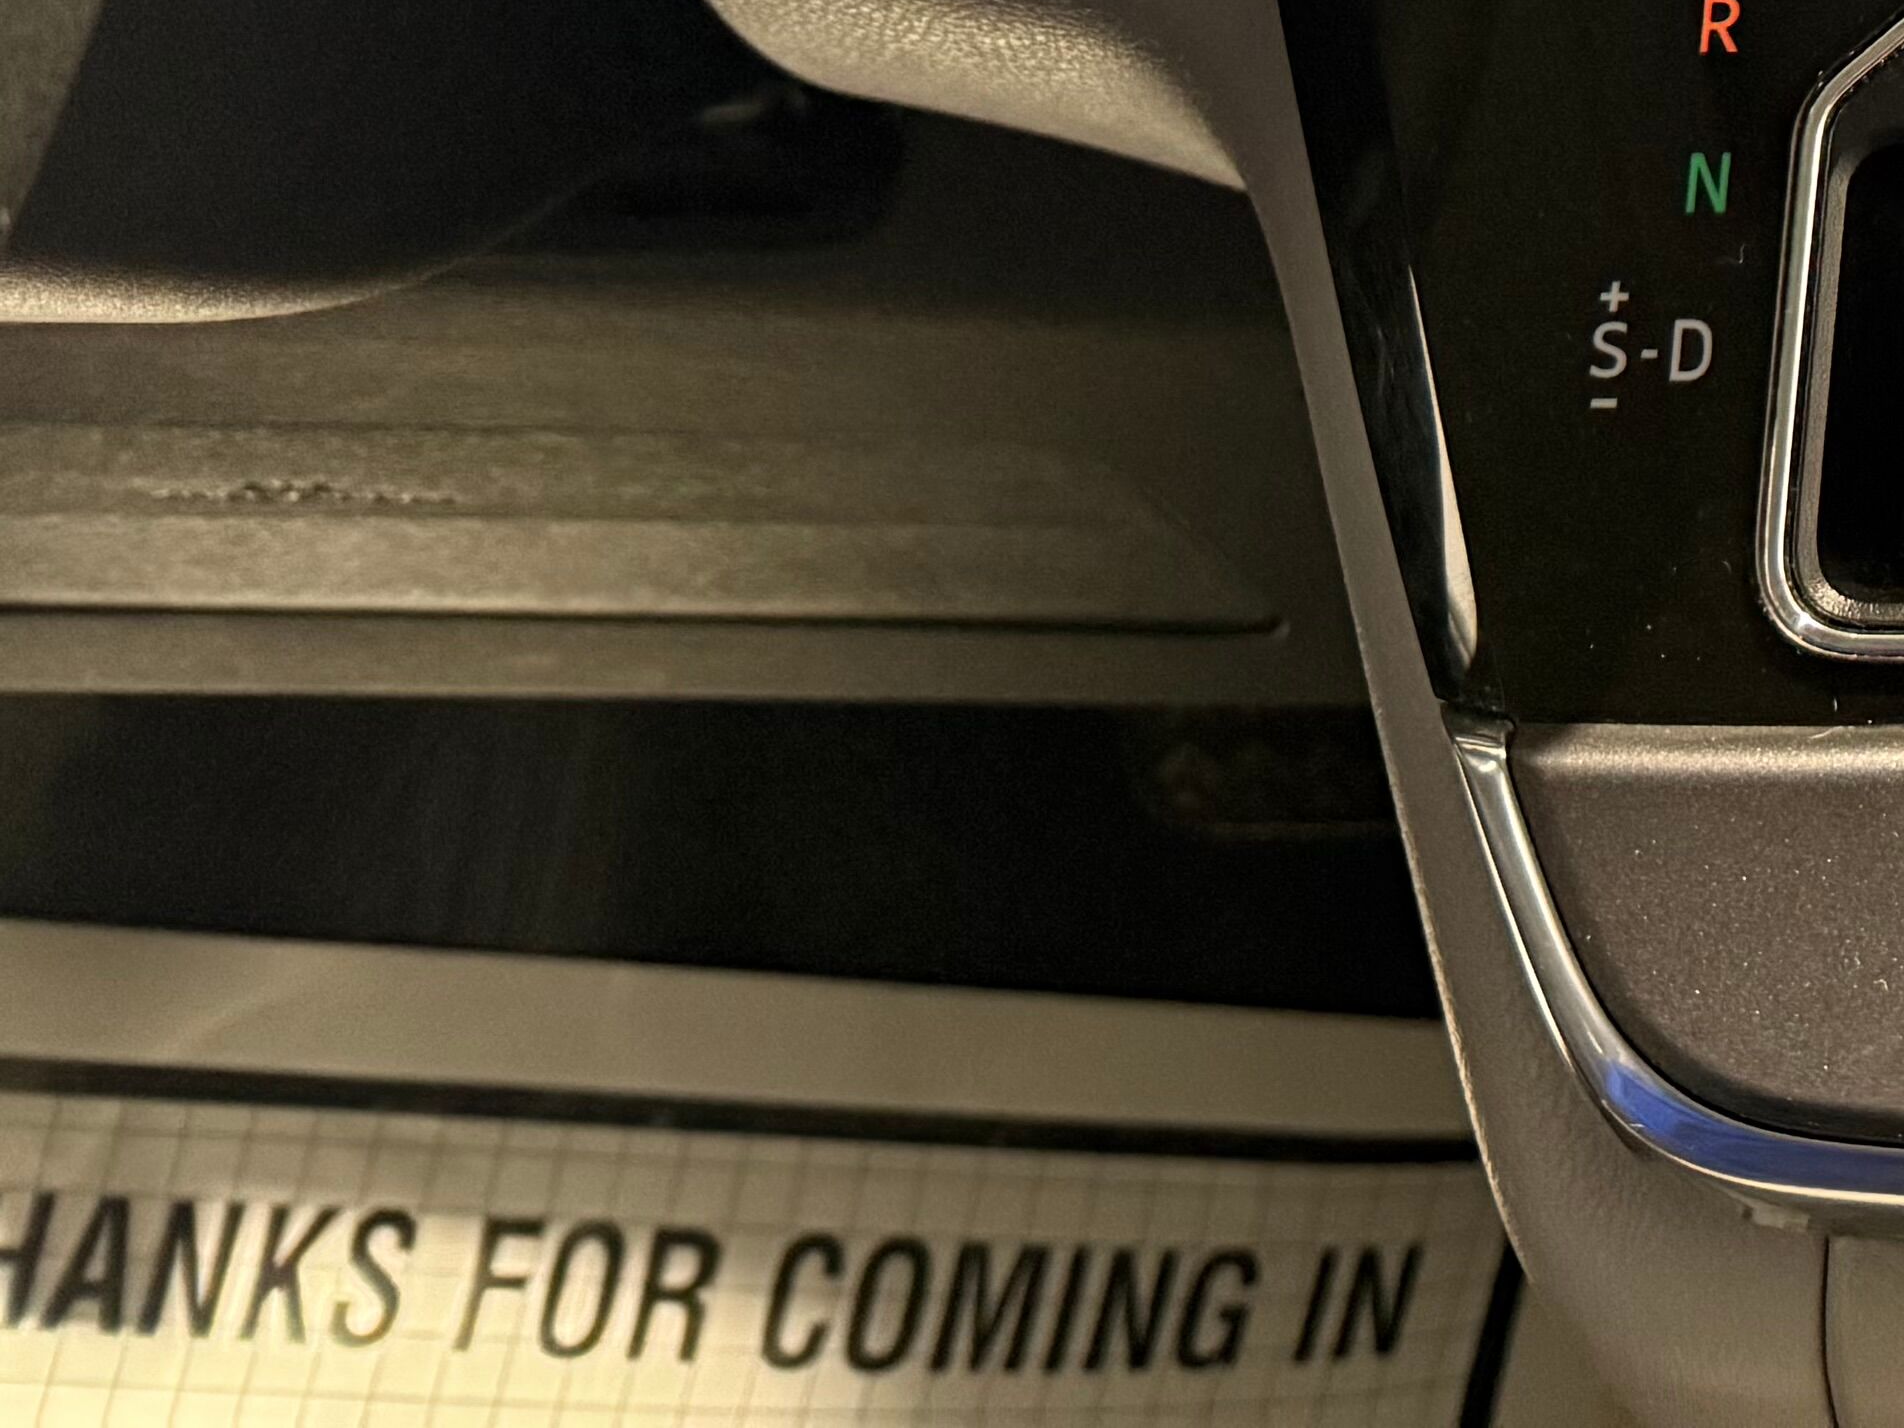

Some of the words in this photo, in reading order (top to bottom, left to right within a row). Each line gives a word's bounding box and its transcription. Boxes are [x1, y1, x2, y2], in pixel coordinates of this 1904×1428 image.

[1685, 153, 1732, 213] N
[453, 1214, 724, 1363] FOR
[761, 1233, 1258, 1373] COMING
[1292, 1244, 1422, 1365] IN
